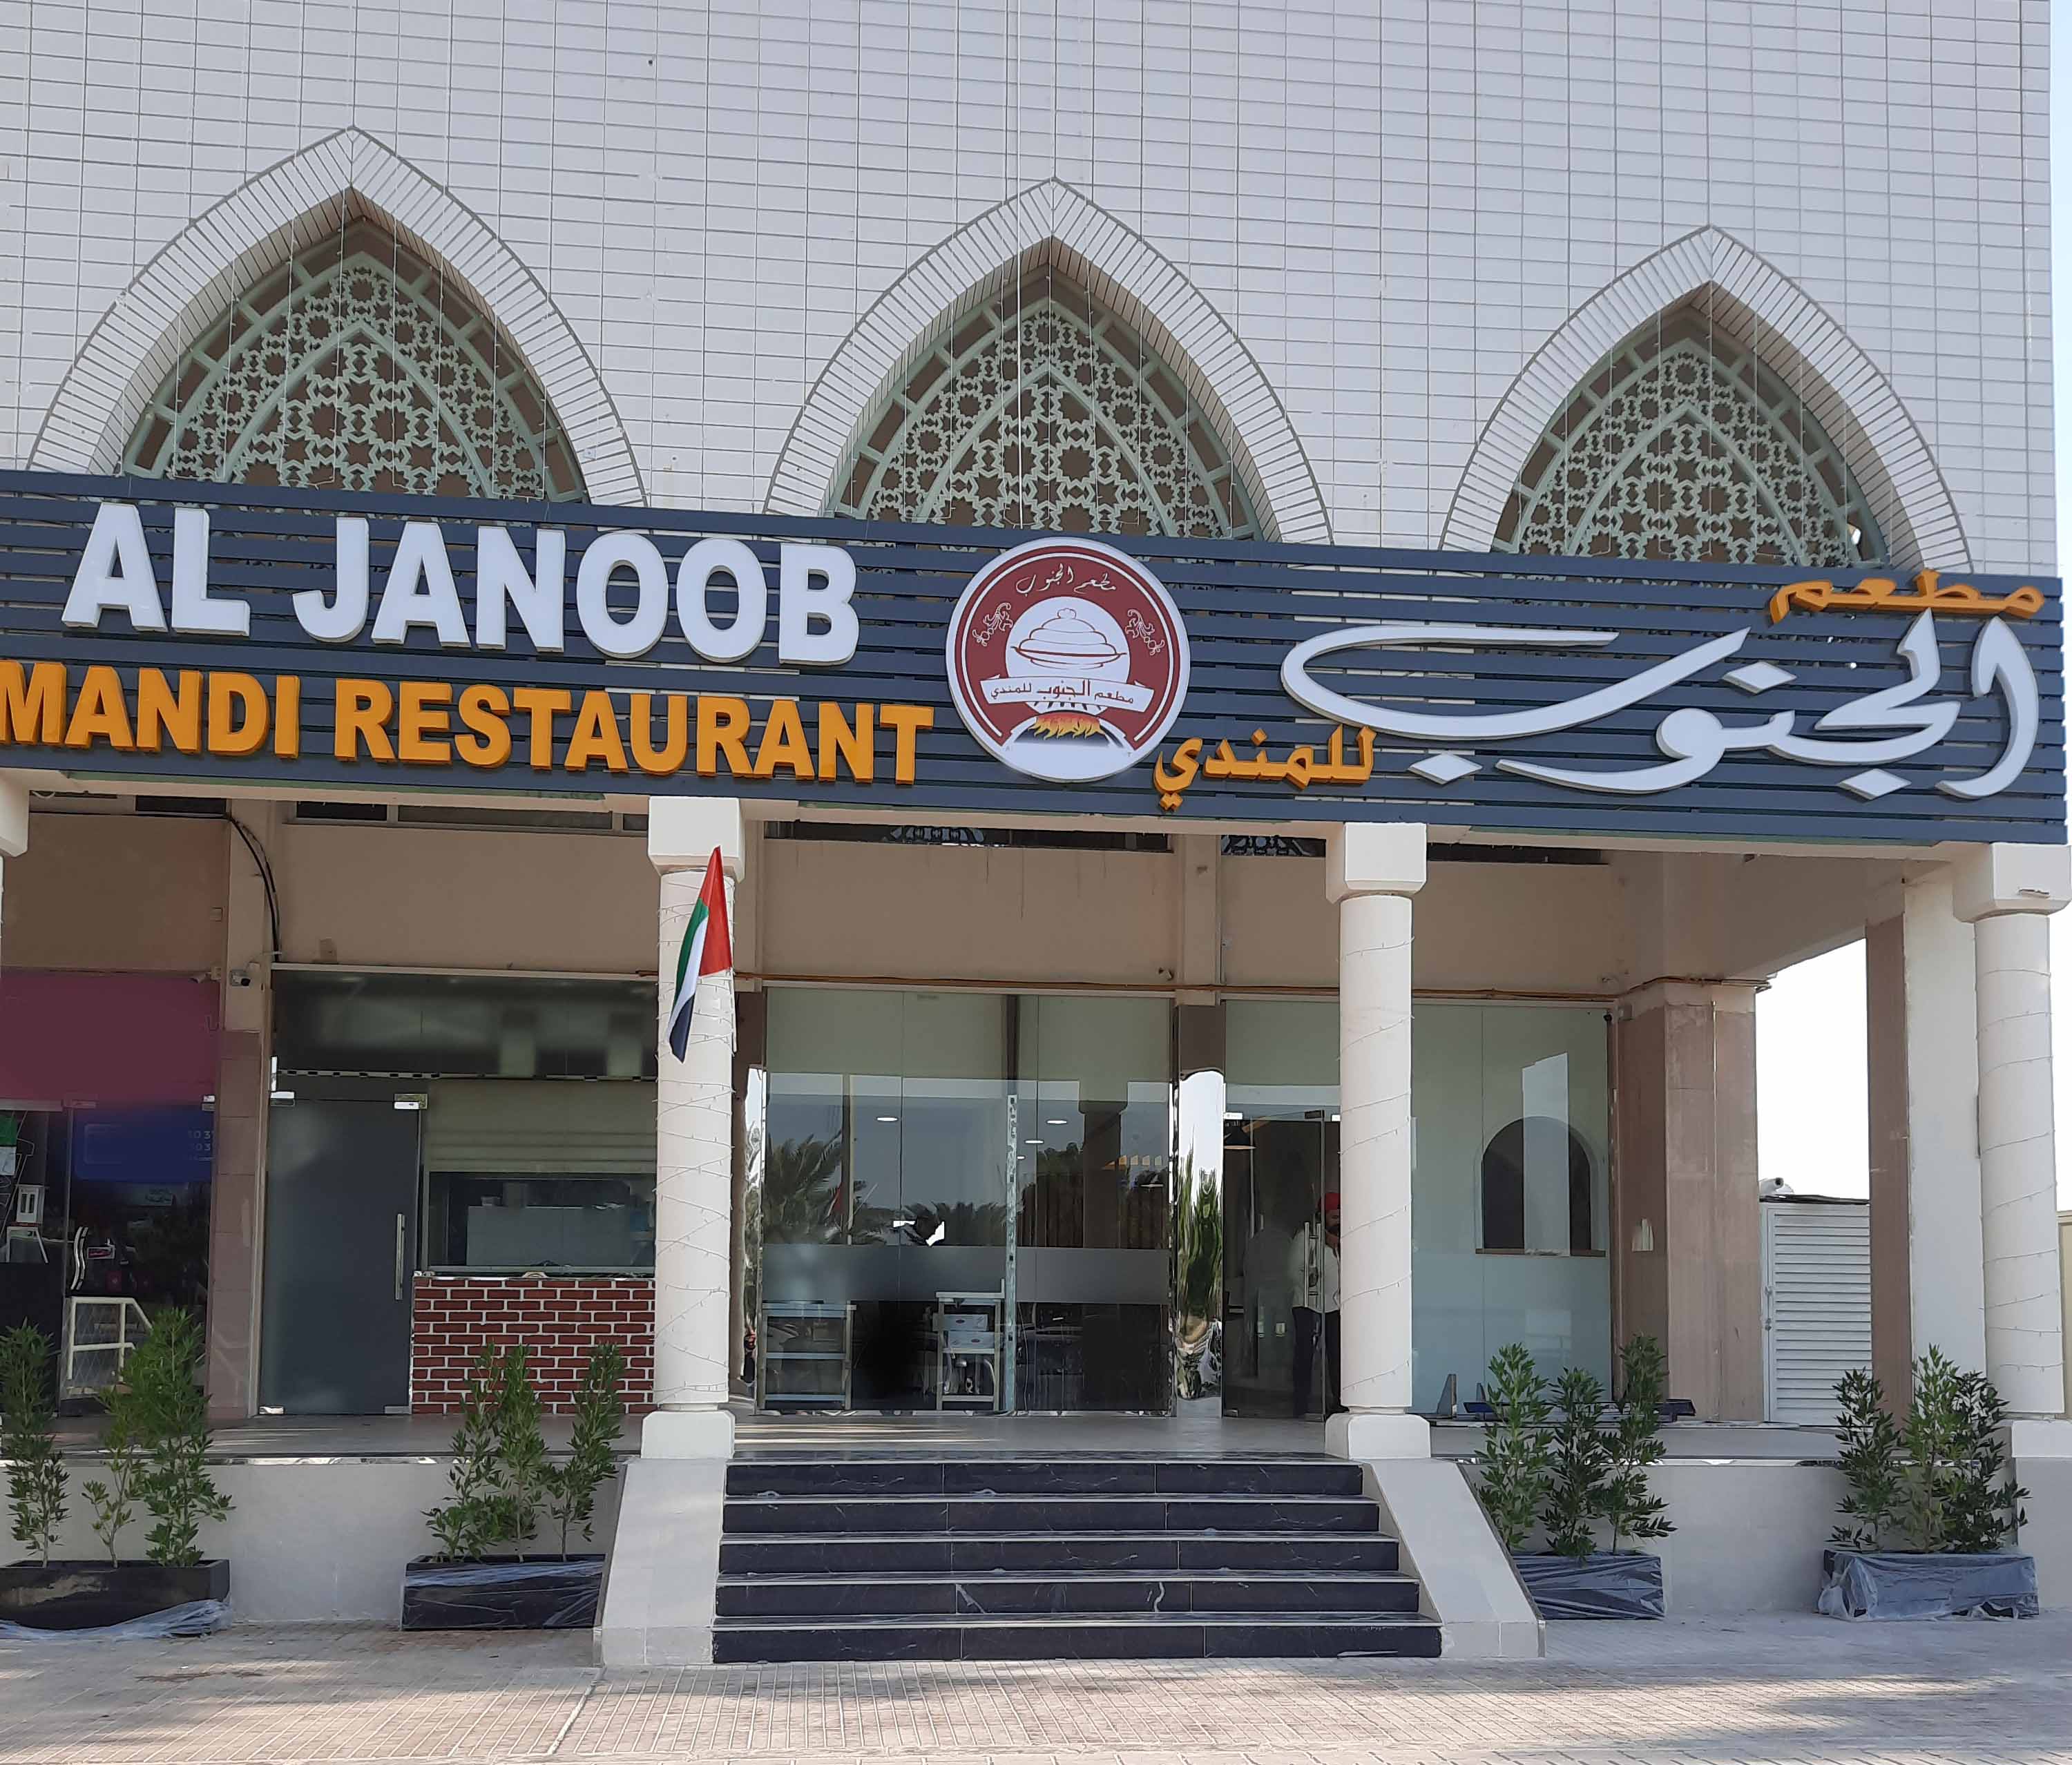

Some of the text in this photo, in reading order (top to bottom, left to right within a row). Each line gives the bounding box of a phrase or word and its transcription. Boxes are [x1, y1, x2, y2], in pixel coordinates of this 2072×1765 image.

[61, 501, 860, 666] AL JANOOB
[1015, 562, 1117, 597] مطعم الجنوب
[1768, 569, 2045, 624] مطعم
[0, 658, 935, 786] MANDI RESTAURANT
[990, 678, 1135, 704] مطعم الجنوب للمندي
[1279, 607, 2040, 801] الجنوب
[1152, 724, 1377, 812] للمندي
